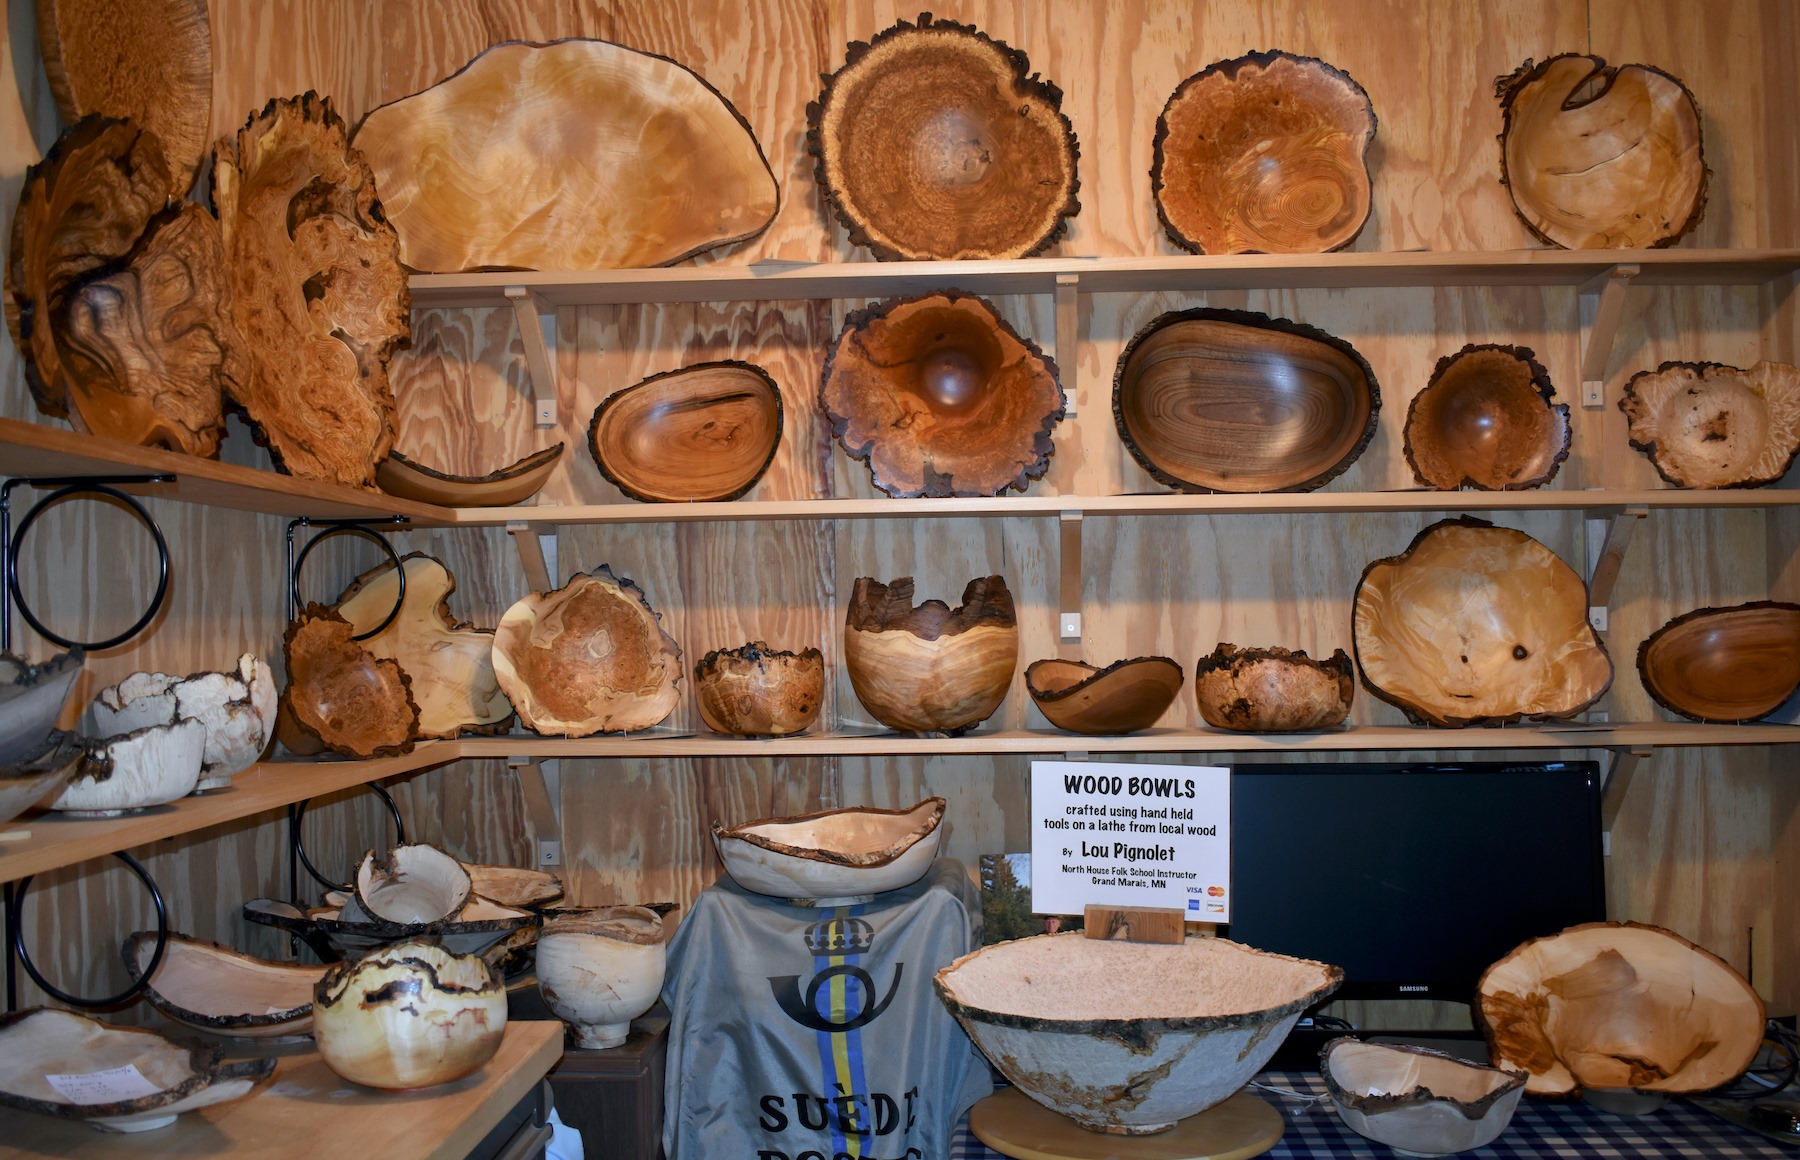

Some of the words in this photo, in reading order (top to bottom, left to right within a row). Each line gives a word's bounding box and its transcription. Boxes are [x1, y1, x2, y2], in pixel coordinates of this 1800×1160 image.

[1064, 774, 1122, 795] WOOD
[1129, 777, 1195, 798] BOWLS
[1066, 804, 1106, 816] crafted
[1110, 807, 1137, 819] using
[1141, 806, 1167, 818] hand
[1171, 808, 1193, 820] held
[1044, 818, 1069, 829] tools
[1073, 821, 1085, 830] on
[1088, 822, 1095, 830] a
[1099, 820, 1126, 832] lathe
[1129, 821, 1156, 833] from
[1159, 823, 1184, 835] local
[1187, 825, 1216, 836] wood
[1063, 848, 1072, 857] By
[1082, 841, 1108, 858] Lou
[1114, 842, 1175, 862] Pignolet
[1062, 864, 1085, 873] North
[1087, 866, 1109, 874] House
[1112, 867, 1127, 875] Folk
[1130, 868, 1155, 877] School
[1157, 869, 1197, 879] Instructor
[1092, 877, 1115, 886] Grand
[1118, 878, 1149, 888] Marais,
[1151, 880, 1166, 889] MN
[1186, 886, 1203, 894] VISA
